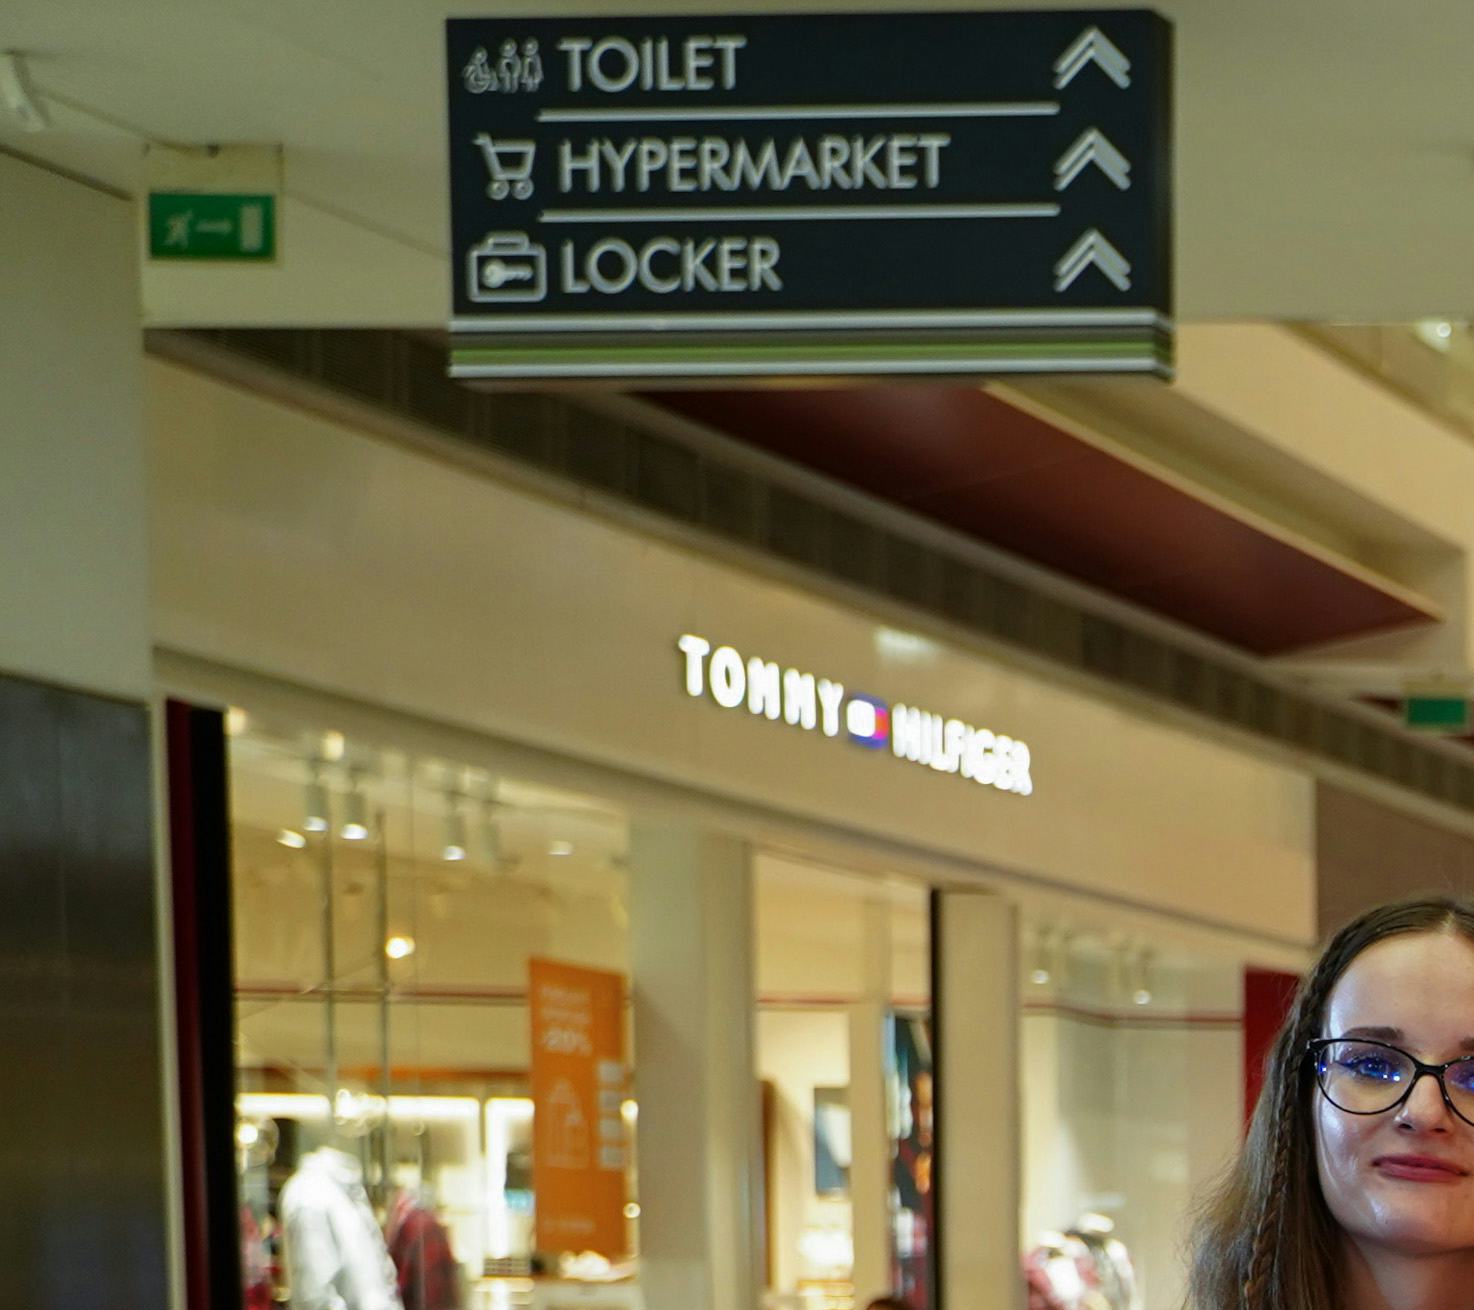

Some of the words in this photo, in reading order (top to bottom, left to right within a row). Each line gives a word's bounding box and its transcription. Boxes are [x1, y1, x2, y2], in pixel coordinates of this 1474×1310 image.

[557, 36, 747, 93] TOILET
[559, 133, 950, 194] HYPERMARKET
[560, 237, 783, 296] LOCKER
[678, 634, 844, 737] TOMMY
[892, 703, 1033, 796] HILFIGER
